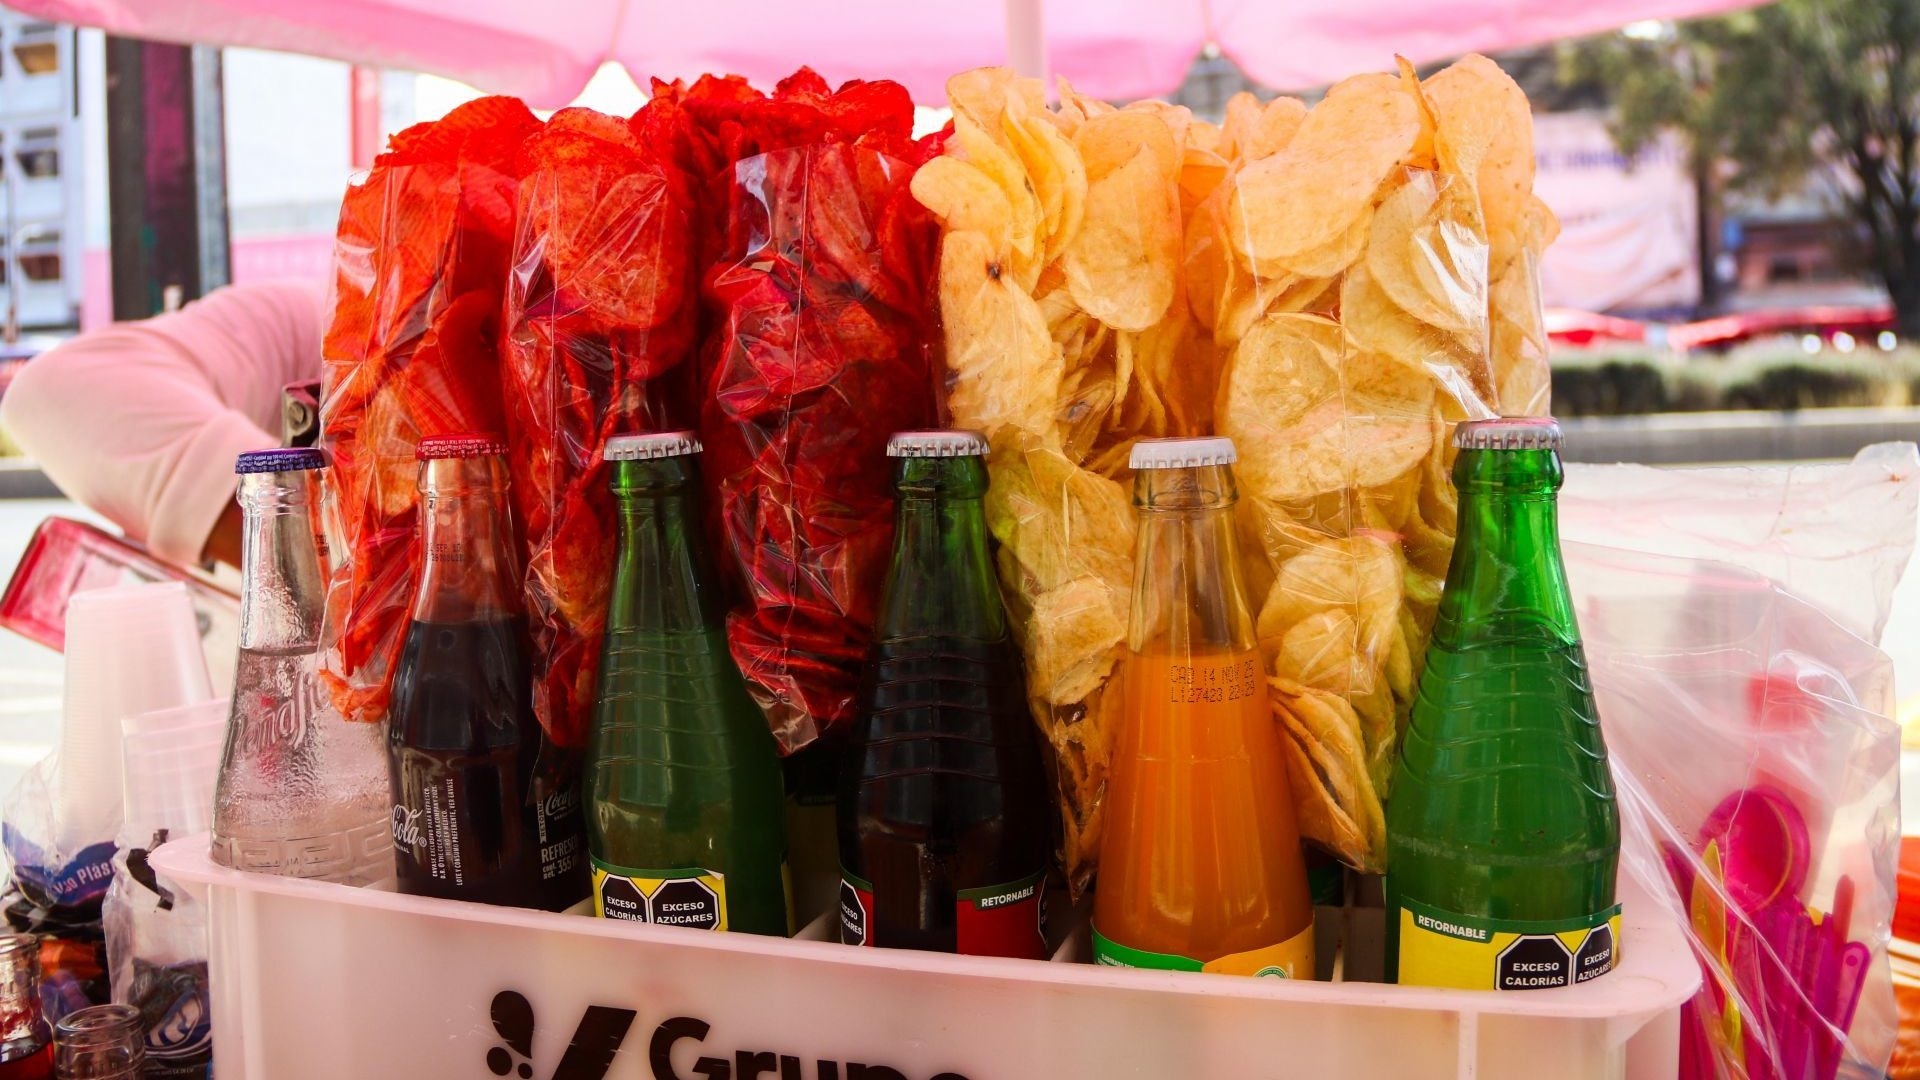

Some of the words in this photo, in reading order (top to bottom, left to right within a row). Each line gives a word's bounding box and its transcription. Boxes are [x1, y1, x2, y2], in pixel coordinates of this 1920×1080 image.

[448, 799, 456, 808] VER
[428, 829, 436, 857] EXCLUSIVO
[434, 824, 444, 852] COCA-COLA
[453, 844, 462, 868] CONSUMO
[606, 896, 637, 910] EXCESO
[981, 885, 1034, 908] RETORNABLE
[662, 901, 705, 912] EXCESO
[605, 907, 643, 923] CALORÍAS
[656, 912, 714, 924] AZÚCARES
[1418, 914, 1487, 940] RETORNABLE
[1584, 948, 1611, 966] EXCESO
[1513, 962, 1560, 972] EXCESO
[1505, 974, 1565, 986] CALORÍAS
